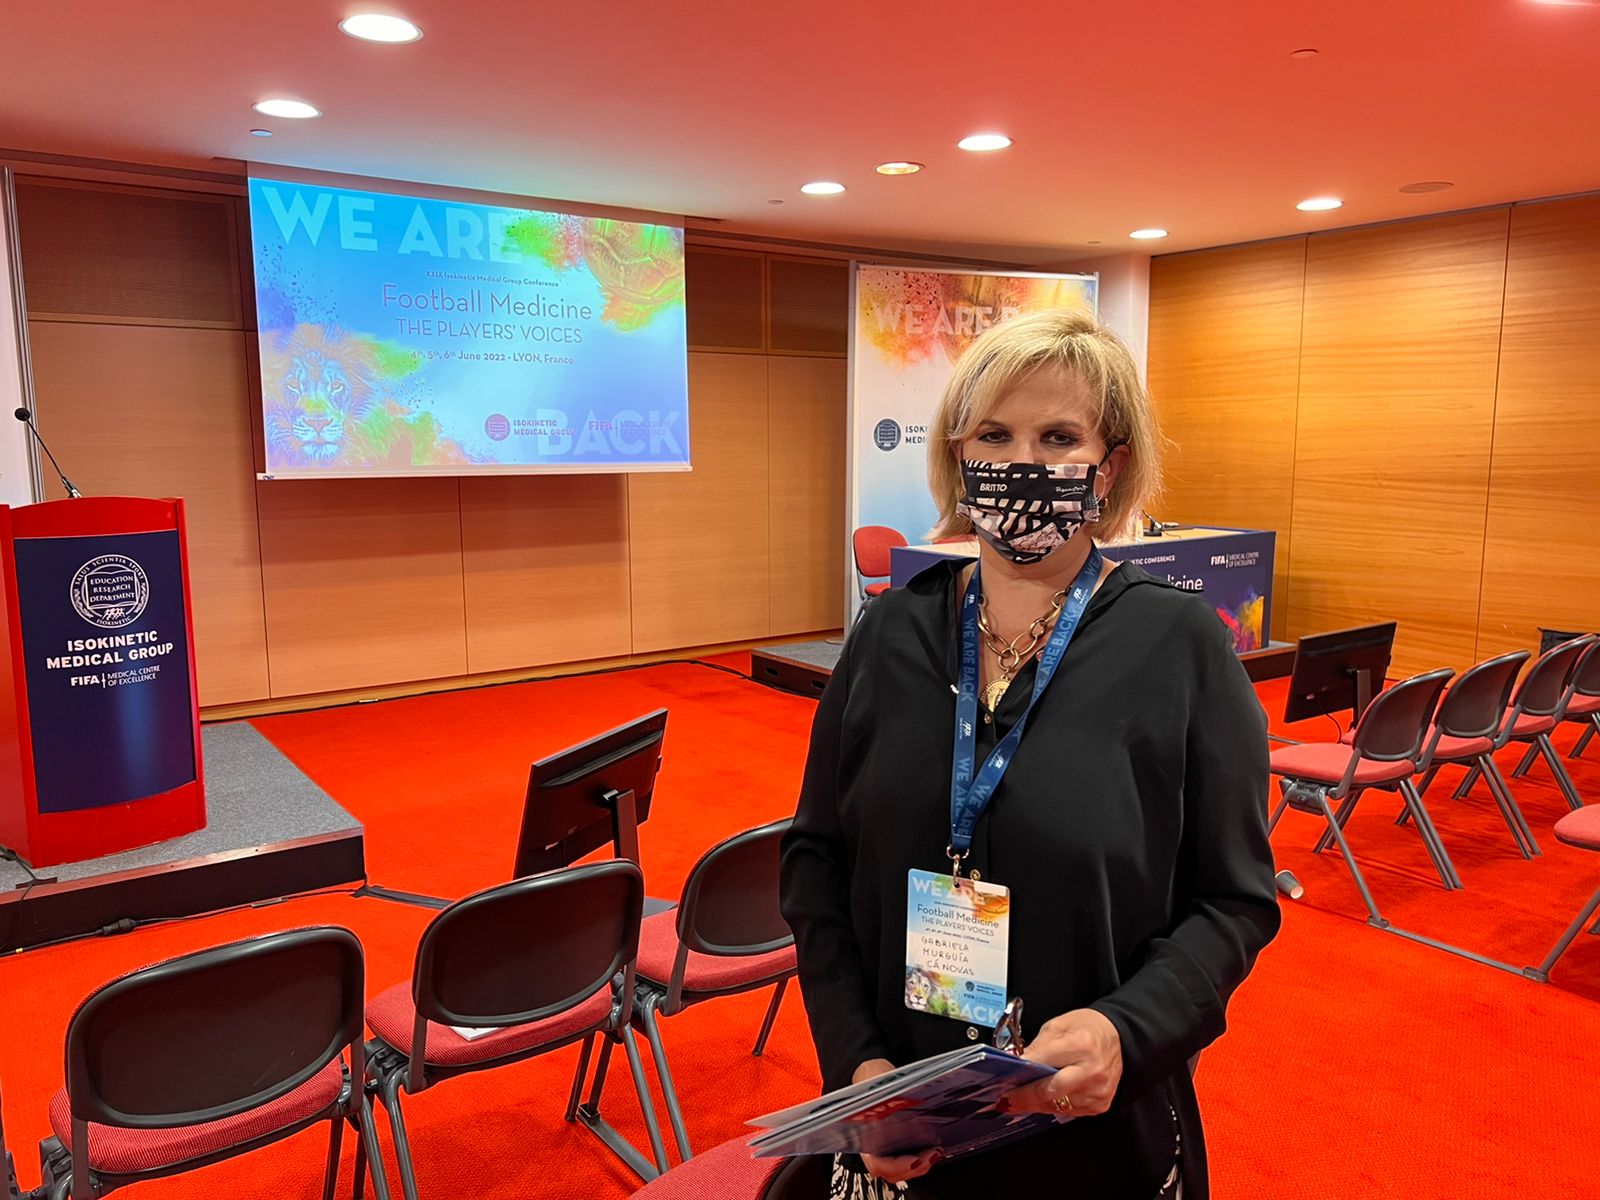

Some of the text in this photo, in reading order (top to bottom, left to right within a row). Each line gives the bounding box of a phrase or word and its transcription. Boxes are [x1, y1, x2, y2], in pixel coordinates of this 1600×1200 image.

[260, 186, 378, 252] WE
[398, 203, 522, 264] ARE
[477, 274, 501, 283] Medical
[503, 276, 522, 286] Group
[523, 279, 559, 288] Conference
[382, 284, 592, 319] Football Medicine
[874, 303, 925, 335] WE
[932, 305, 993, 336] ARE
[396, 318, 433, 336] THE
[520, 325, 583, 344] VOICES
[458, 351, 481, 361] June
[483, 352, 506, 361] 2022
[513, 419, 557, 427] ISOKINETIC
[588, 420, 614, 431] FIFA
[514, 428, 548, 436] MEDICAL
[536, 409, 681, 456] BACK
[979, 483, 1008, 492] BRITTO
[1144, 555, 1175, 565] CONFERENCE
[1210, 555, 1226, 566] FIFA
[75, 566, 91, 585] SALUS
[92, 557, 127, 567] SCIENTIA
[90, 575, 134, 585] EDUCATION
[93, 584, 131, 593] RESEARCH
[90, 592, 136, 603] DEPARTMENT
[96, 616, 132, 626] ISOKINETIC
[67, 630, 158, 652] ISOKINETIC
[1042, 647, 1060, 675] ARE
[1052, 611, 1077, 647] BACK
[46, 642, 174, 669] MEDICAL GROUP
[961, 619, 976, 703] WE ARE BACK
[70, 675, 100, 686] FIFA
[107, 665, 161, 680] MEDICAL CENTRE
[107, 672, 157, 687] OF EXCELLENCE
[955, 757, 971, 818] WE AR
[969, 784, 991, 808] WE
[911, 876, 944, 897] WE
[917, 903, 954, 918] Football
[956, 912, 1000, 928] Medicine
[921, 915, 934, 924] THE
[968, 925, 995, 937] VOICES
[921, 936, 969, 952] GABRIELA
